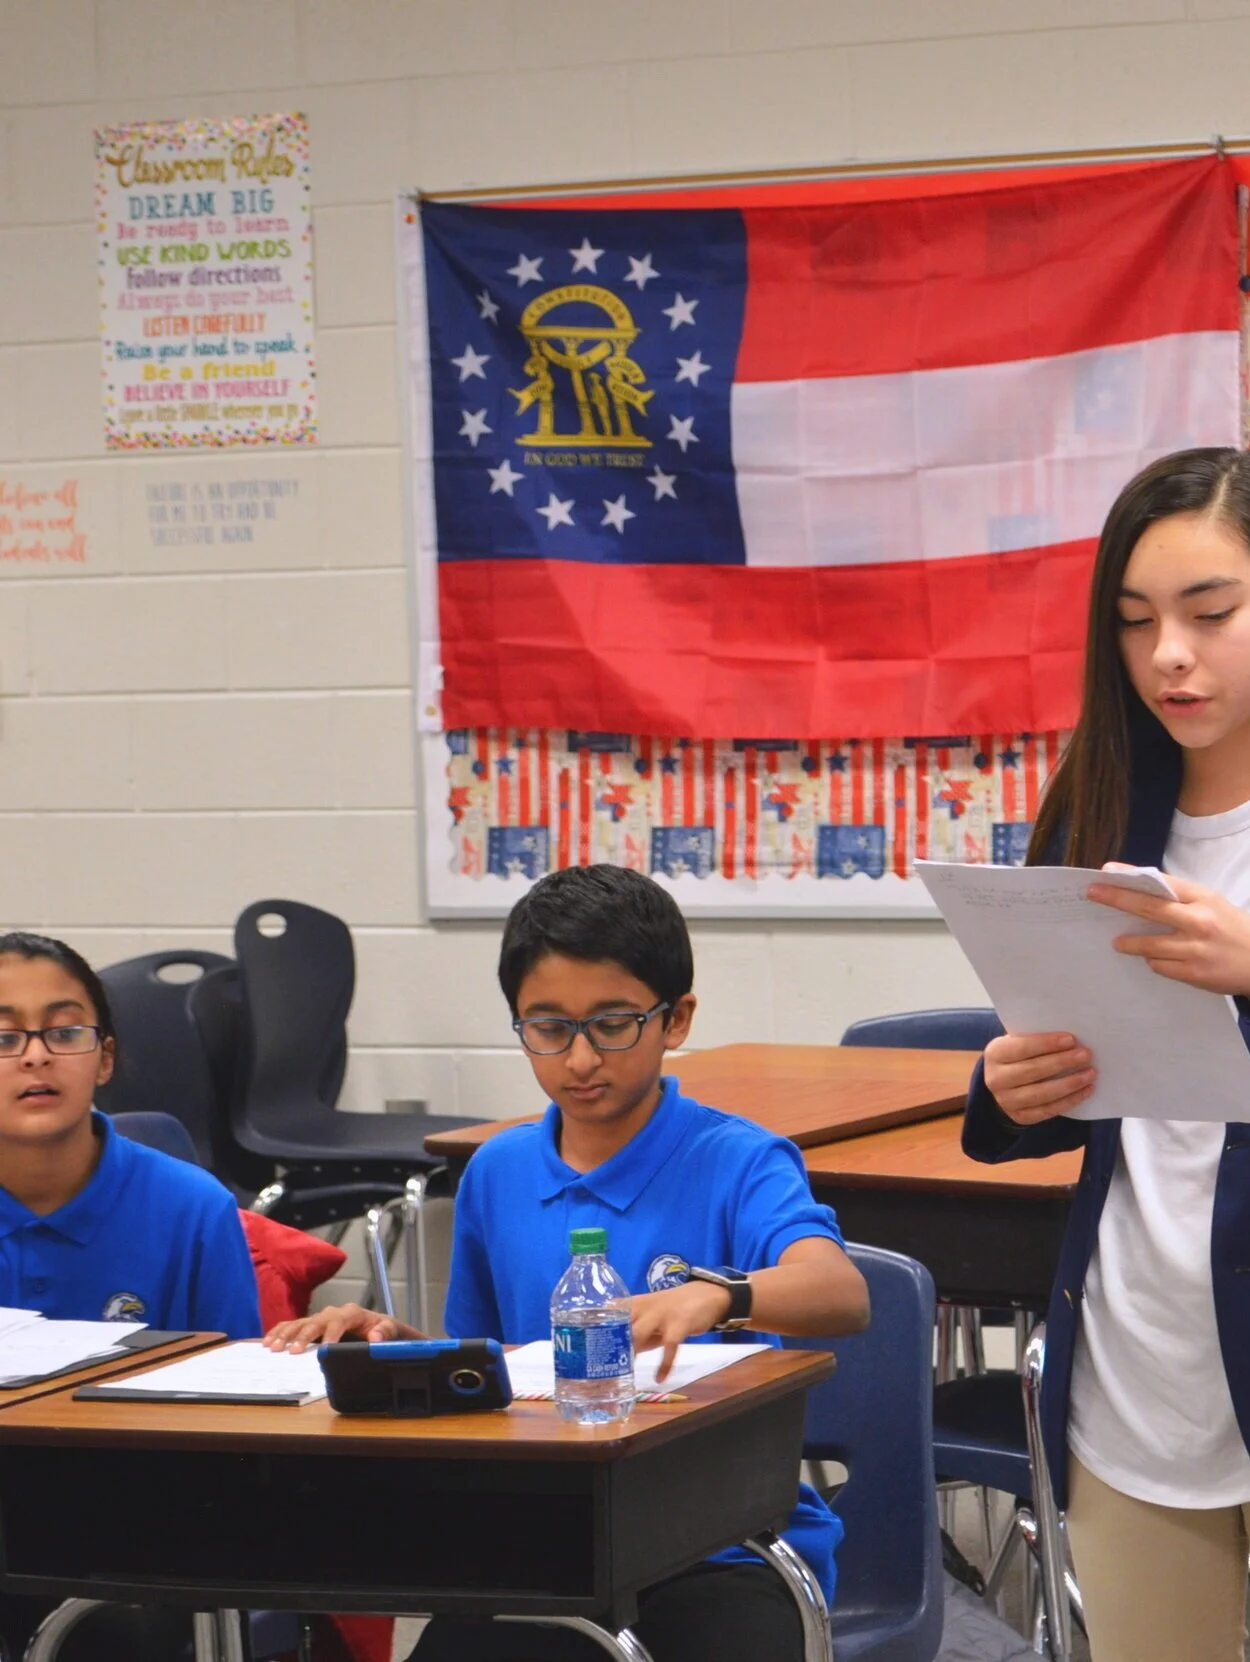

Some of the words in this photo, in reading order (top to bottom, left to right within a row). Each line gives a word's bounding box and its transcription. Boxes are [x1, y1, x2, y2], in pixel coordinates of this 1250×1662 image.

[105, 146, 226, 188] Classroom
[231, 133, 296, 184] Rules
[128, 192, 216, 220] DREAM
[230, 189, 275, 215] BIG
[116, 223, 137, 240] Be
[146, 220, 198, 241] ready
[206, 219, 226, 235] to
[235, 217, 290, 234] learn
[116, 247, 152, 266] USE
[160, 243, 210, 264] KIND
[216, 240, 292, 261] WORDS
[188, 264, 282, 286] directions
[117, 292, 180, 313] Always
[185, 290, 204, 308] do
[208, 291, 251, 311] your
[256, 286, 294, 303] best
[143, 316, 190, 337] LISTEN
[194, 312, 267, 335] CAREFULLY
[115, 341, 152, 360] Raise
[158, 344, 187, 364] your
[192, 336, 228, 357] hand
[233, 339, 250, 354] to
[255, 333, 298, 362] speak
[143, 363, 172, 381] Be
[180, 366, 193, 380] a
[203, 360, 276, 380] friend
[124, 383, 186, 402] BELIEVE
[191, 381, 209, 399] IN
[215, 379, 290, 398] YOURSELF
[524, 452, 543, 466] IN
[545, 453, 578, 466] GOD
[579, 454, 602, 467] WE
[606, 453, 645, 468] TRUST
